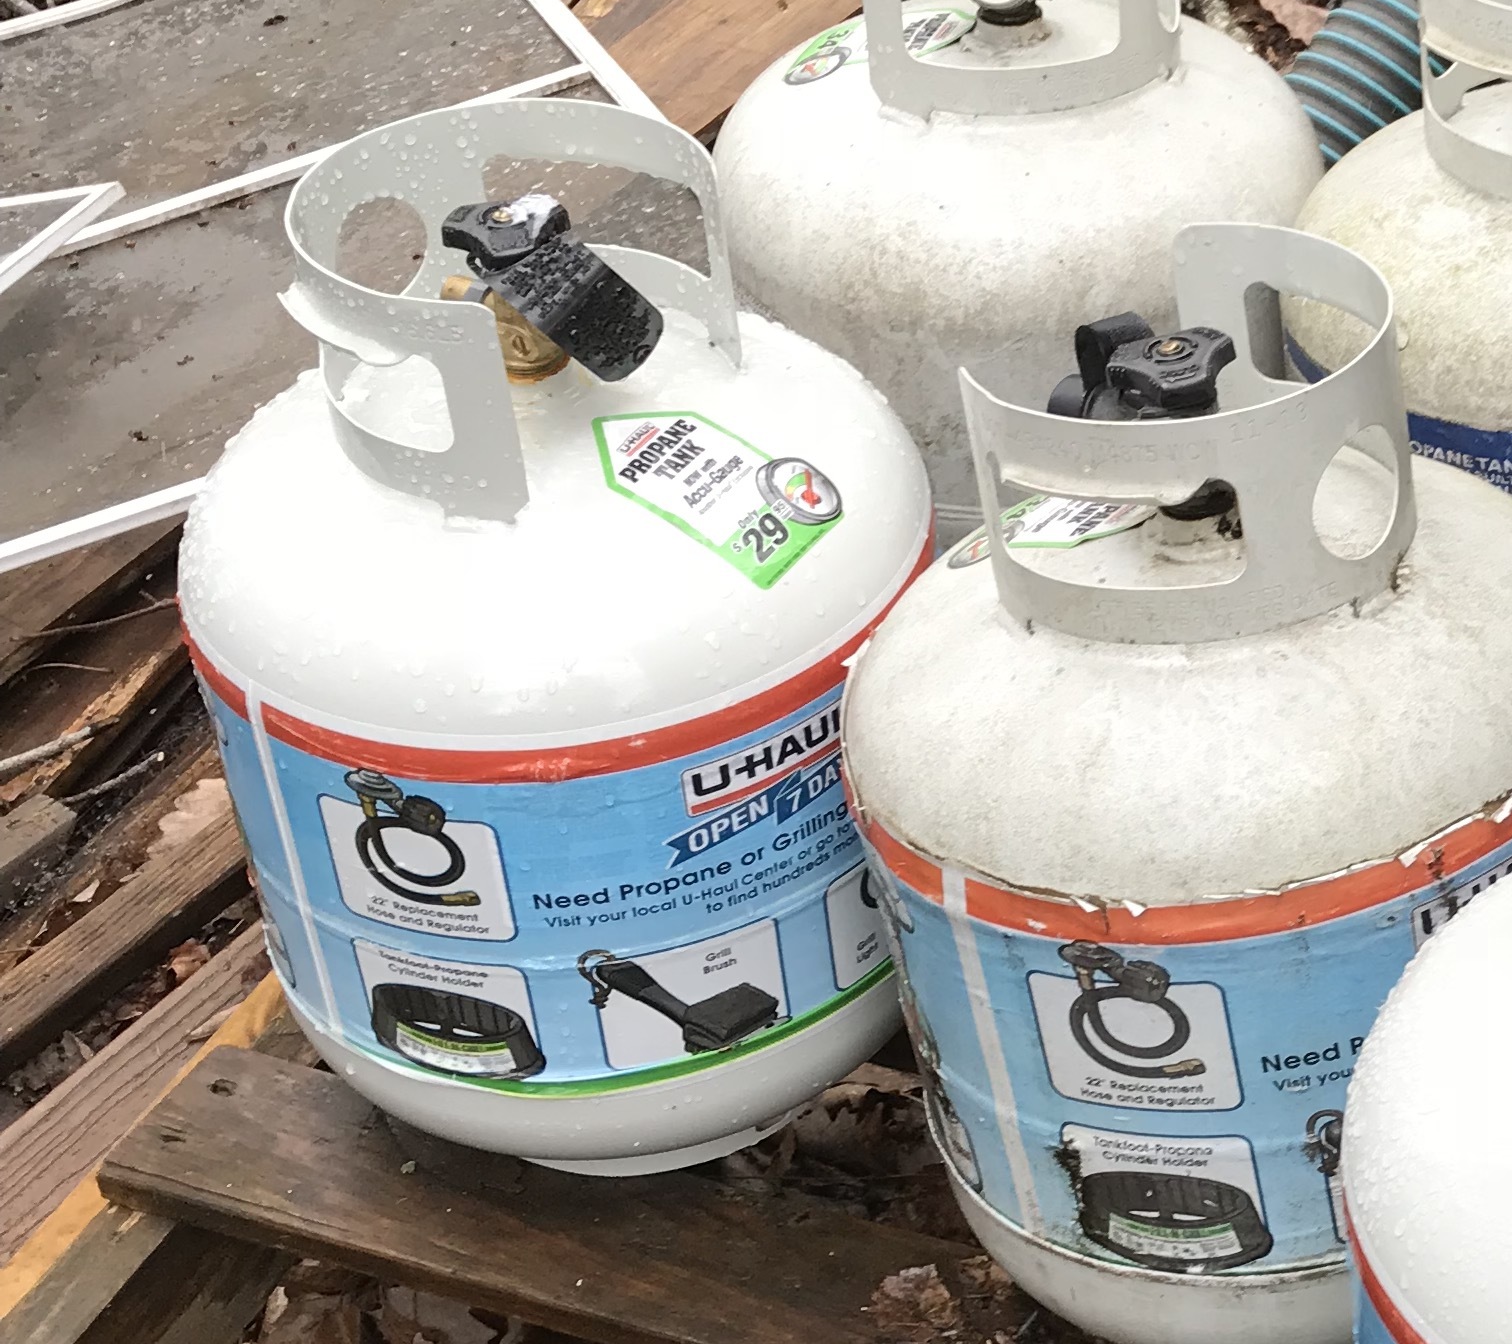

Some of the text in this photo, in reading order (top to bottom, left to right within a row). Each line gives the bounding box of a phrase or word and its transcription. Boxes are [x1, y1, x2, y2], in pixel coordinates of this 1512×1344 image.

[618, 419, 697, 483] PROPANE
[652, 439, 705, 480] TANK
[682, 455, 744, 508] Accu-Gauge
[688, 757, 841, 852] OPEN 7 DA
[532, 800, 849, 909] Need Propane or Grilling
[545, 824, 849, 927] Visit your local U-Haul Center or go to
[706, 852, 830, 914] to find hundreds
[392, 902, 478, 921] Replacement
[399, 915, 423, 926] and
[427, 920, 490, 934] Regulator
[703, 957, 737, 974] Brush
[705, 948, 731, 962] Grill
[388, 964, 484, 988] Cylinder Holder
[1262, 1042, 1340, 1073] Need
[1110, 1081, 1203, 1093] Replacement
[1273, 1067, 1354, 1091] Visit you
[1117, 1094, 1143, 1104] and
[1147, 1096, 1216, 1107] Regulator
[1102, 1151, 1208, 1167] Cylinder Holder
